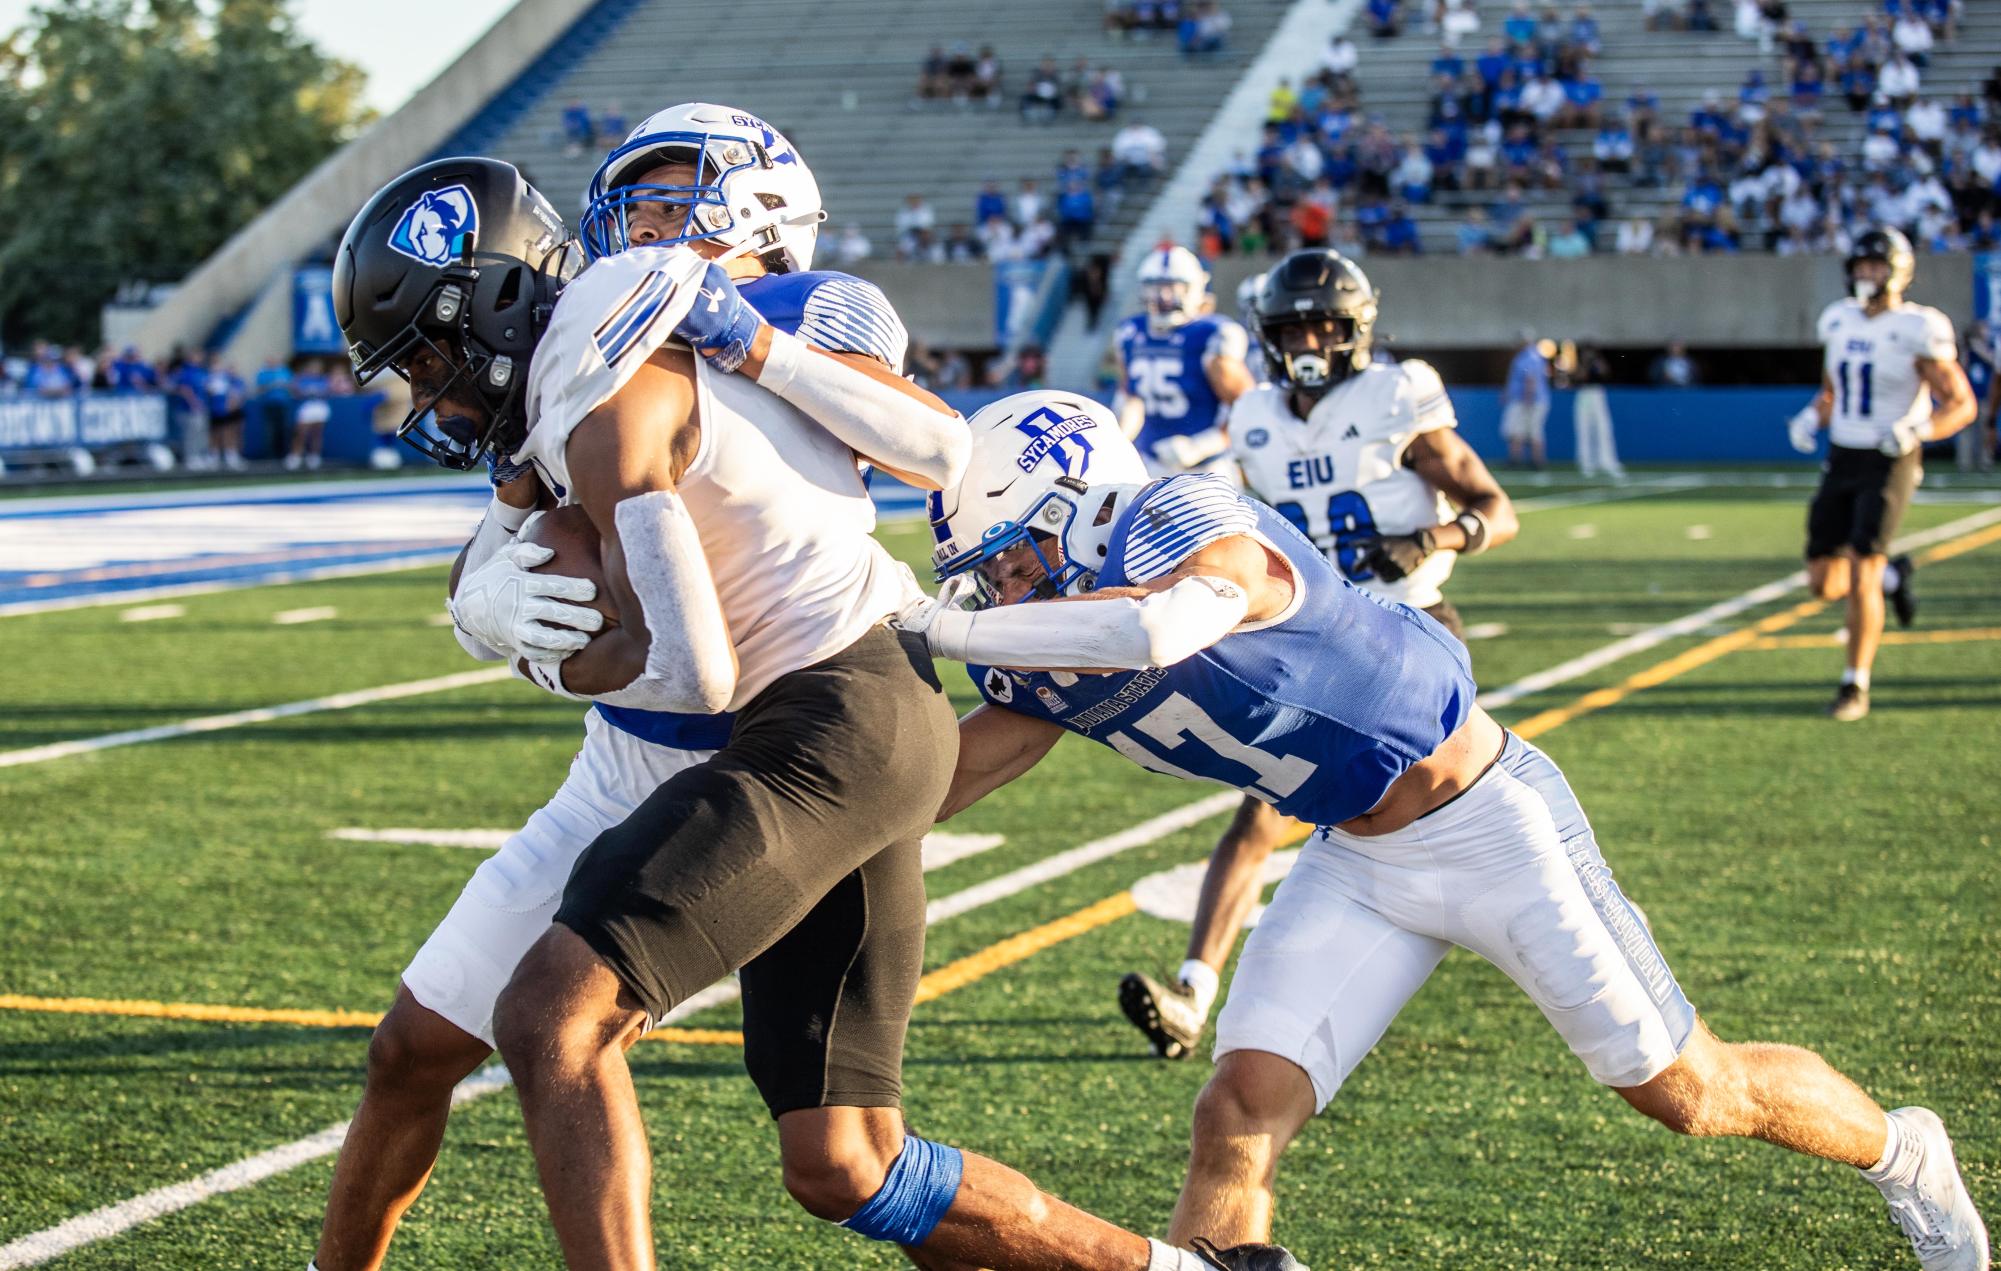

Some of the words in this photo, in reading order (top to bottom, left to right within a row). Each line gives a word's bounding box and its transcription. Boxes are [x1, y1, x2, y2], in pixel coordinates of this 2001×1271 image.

[1839, 361, 1873, 416] 11
[1018, 415, 1097, 473] SYCAMORES
[1288, 455, 1334, 489] EIU
[947, 541, 960, 556] IN
[1114, 666, 1168, 704] STATE
[1106, 691, 1318, 804] 17
